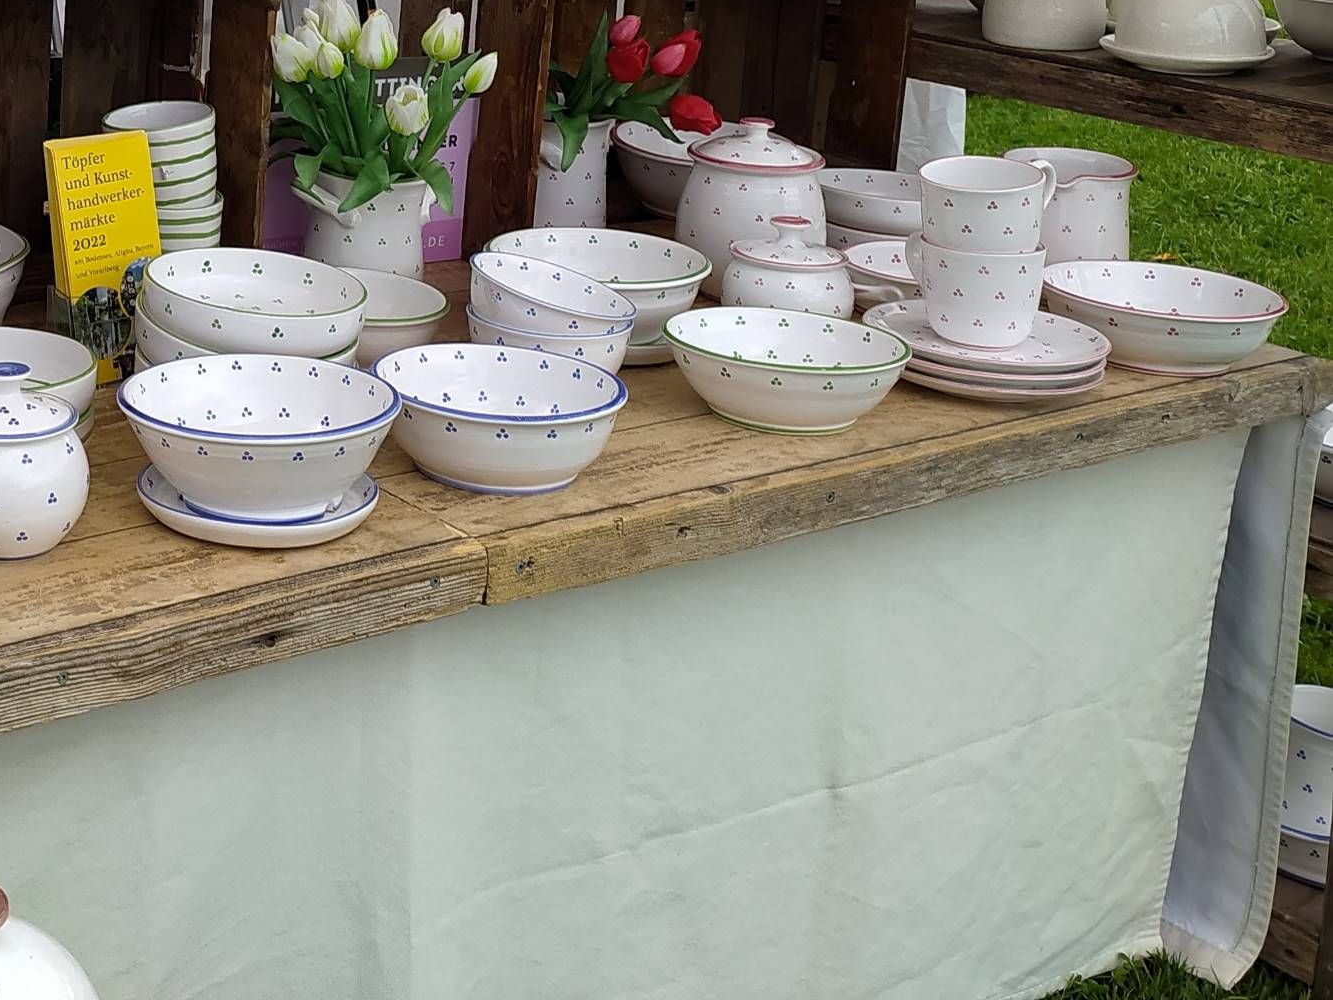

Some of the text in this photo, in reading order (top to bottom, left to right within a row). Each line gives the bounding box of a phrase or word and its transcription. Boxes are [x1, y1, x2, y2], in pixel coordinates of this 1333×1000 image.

[60, 152, 106, 171] Töpfer
[65, 169, 133, 191] und Kunst-
[67, 187, 145, 211] handwerker-
[70, 213, 116, 232] märkte
[72, 234, 107, 252] 2022
